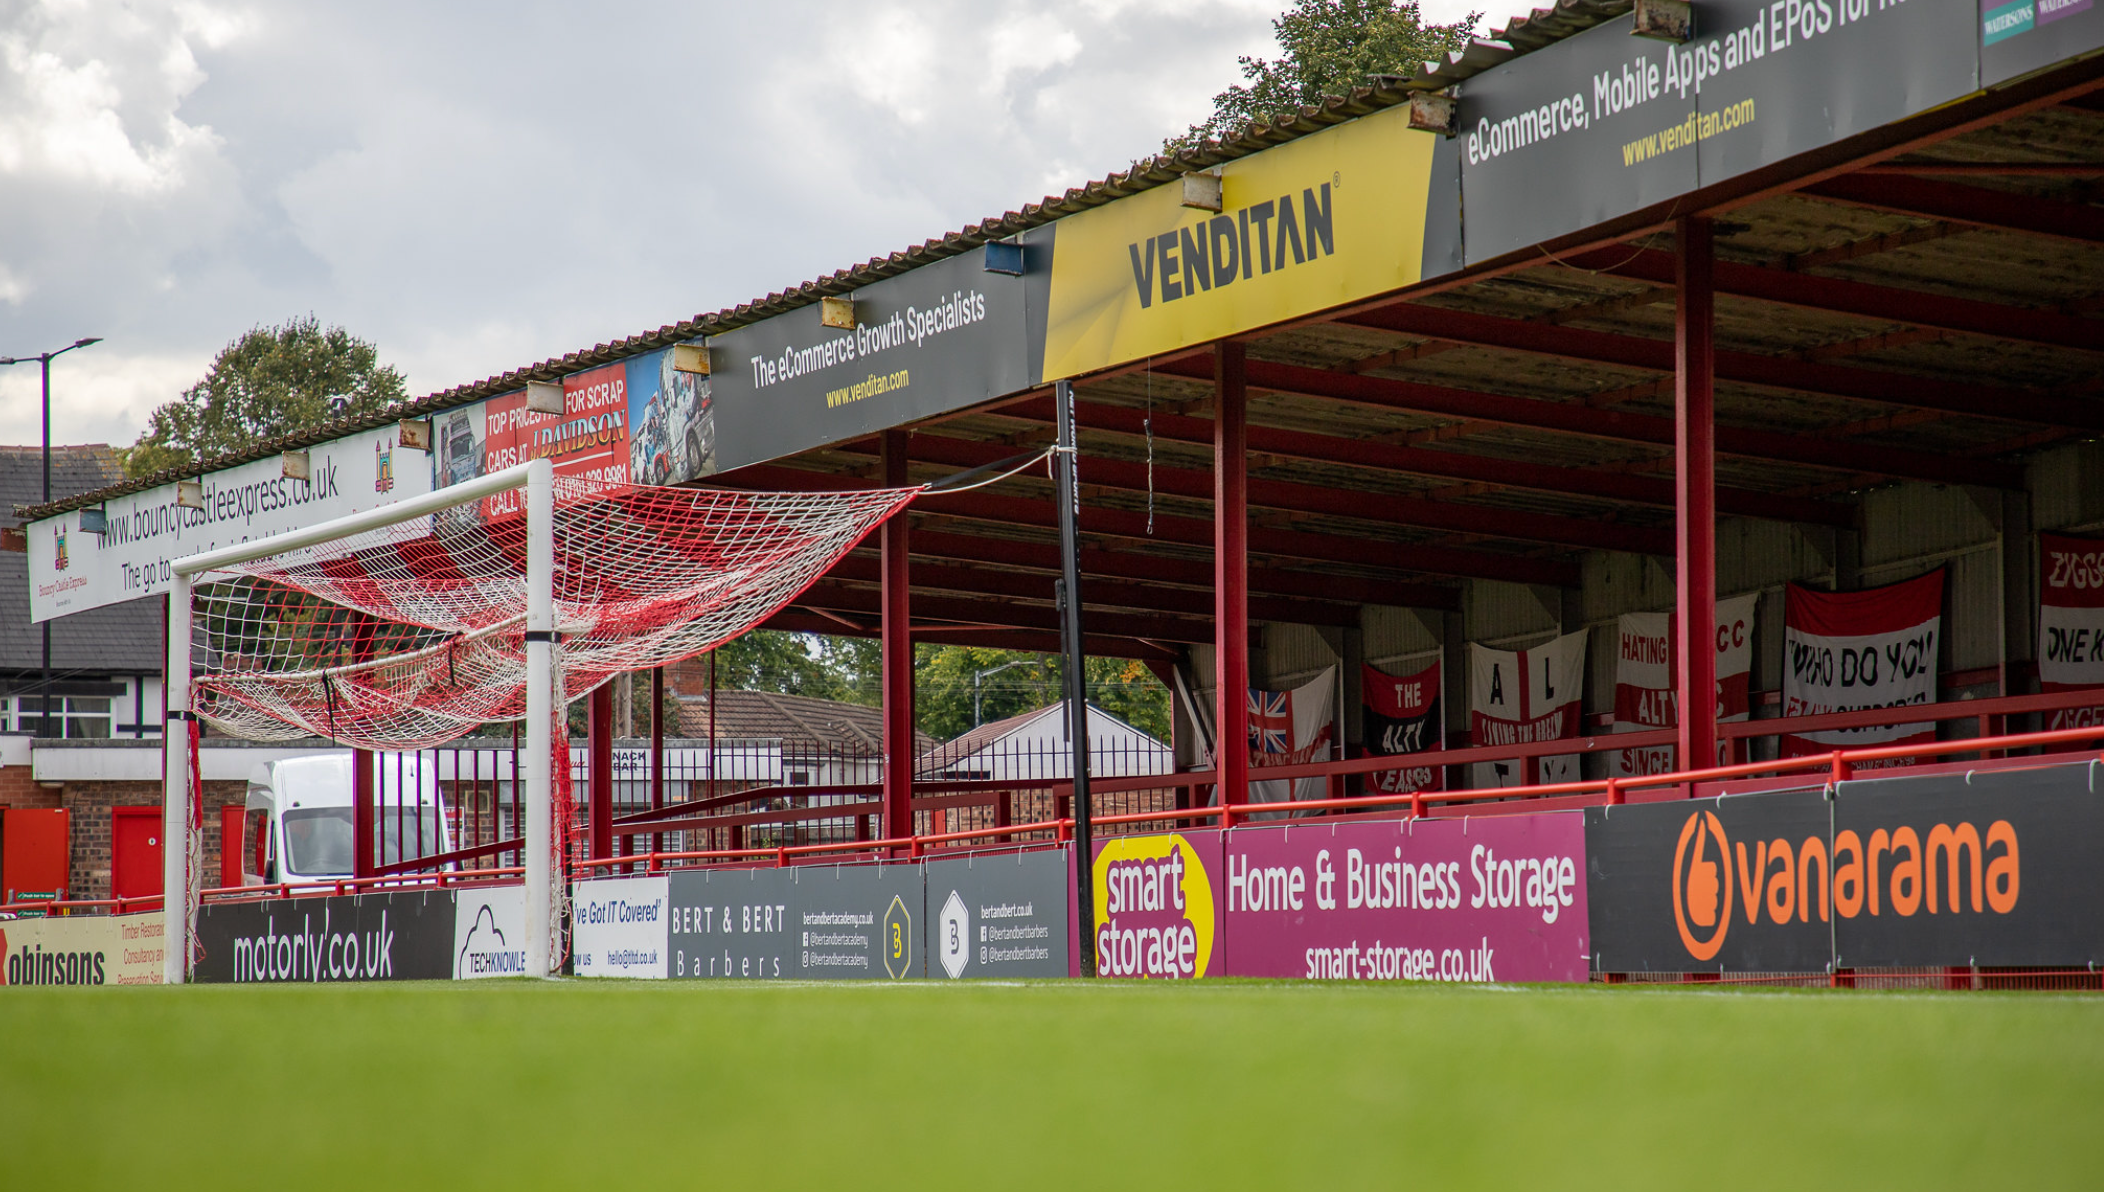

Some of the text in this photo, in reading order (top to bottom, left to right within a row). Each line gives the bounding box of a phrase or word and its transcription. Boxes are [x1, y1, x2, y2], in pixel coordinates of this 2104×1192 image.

[1984, 4, 2033, 35] WATERSONS
[1468, 94, 1590, 166] eCommerce,
[1594, 56, 1660, 119] Mobile
[1664, 40, 1720, 99] Apps
[1725, 8, 1765, 70] and
[1771, 0, 1833, 52] EPoS
[1622, 97, 1756, 167] www.venditan.com
[1128, 182, 1335, 310] VENDITAN
[751, 290, 986, 389] The eCommerce Growth Specialists
[826, 367, 910, 409] www.venditan.com
[488, 411, 508, 436] TOP
[565, 389, 585, 415] FOR
[587, 379, 624, 409] SCRAP
[488, 446, 517, 473] CARS
[518, 443, 528, 465] AT
[530, 409, 626, 461] J.DAVIDSON
[97, 455, 339, 550] www.bouncycastleexpress.co.uk
[490, 490, 518, 516] CALL
[604, 463, 627, 490] 9981
[121, 556, 170, 593] The go to
[1622, 619, 1745, 665] HATING CC
[2048, 626, 2089, 663] ONE
[1490, 657, 1554, 705] A L
[1841, 646, 1878, 687] DO
[1394, 682, 1422, 708] THE
[1382, 719, 1426, 753] ALTY
[1517, 724, 1533, 743] THE
[612, 751, 646, 761] NACK
[613, 762, 638, 771] BAR
[1620, 748, 1669, 775] SINCE
[1108, 851, 1184, 914] smart
[1228, 844, 1576, 924] Home & Business Storage
[1736, 820, 2020, 925] vanarama
[589, 900, 606, 924] Got
[607, 900, 618, 923] IT
[672, 904, 785, 934] BERT & BERT
[803, 910, 874, 929] bertandbertacademy.co.uk
[981, 900, 1034, 919] bertandbert.co.uk
[121, 923, 139, 940] Timber
[810, 931, 869, 949] @bertandbertacademy
[988, 923, 1049, 942] @bertandbertbarbers
[1099, 918, 1195, 979] storage
[8, 944, 105, 985] obinsons
[123, 947, 164, 967] Consultancy an
[469, 950, 526, 973] TECHKNOWLE
[583, 953, 592, 966] us
[677, 949, 780, 977] Barbers
[810, 951, 869, 970] @bertandbertacademy
[988, 944, 1049, 963] @bertandbertbarbers
[1305, 936, 1495, 982] smart-storage.co.uk
